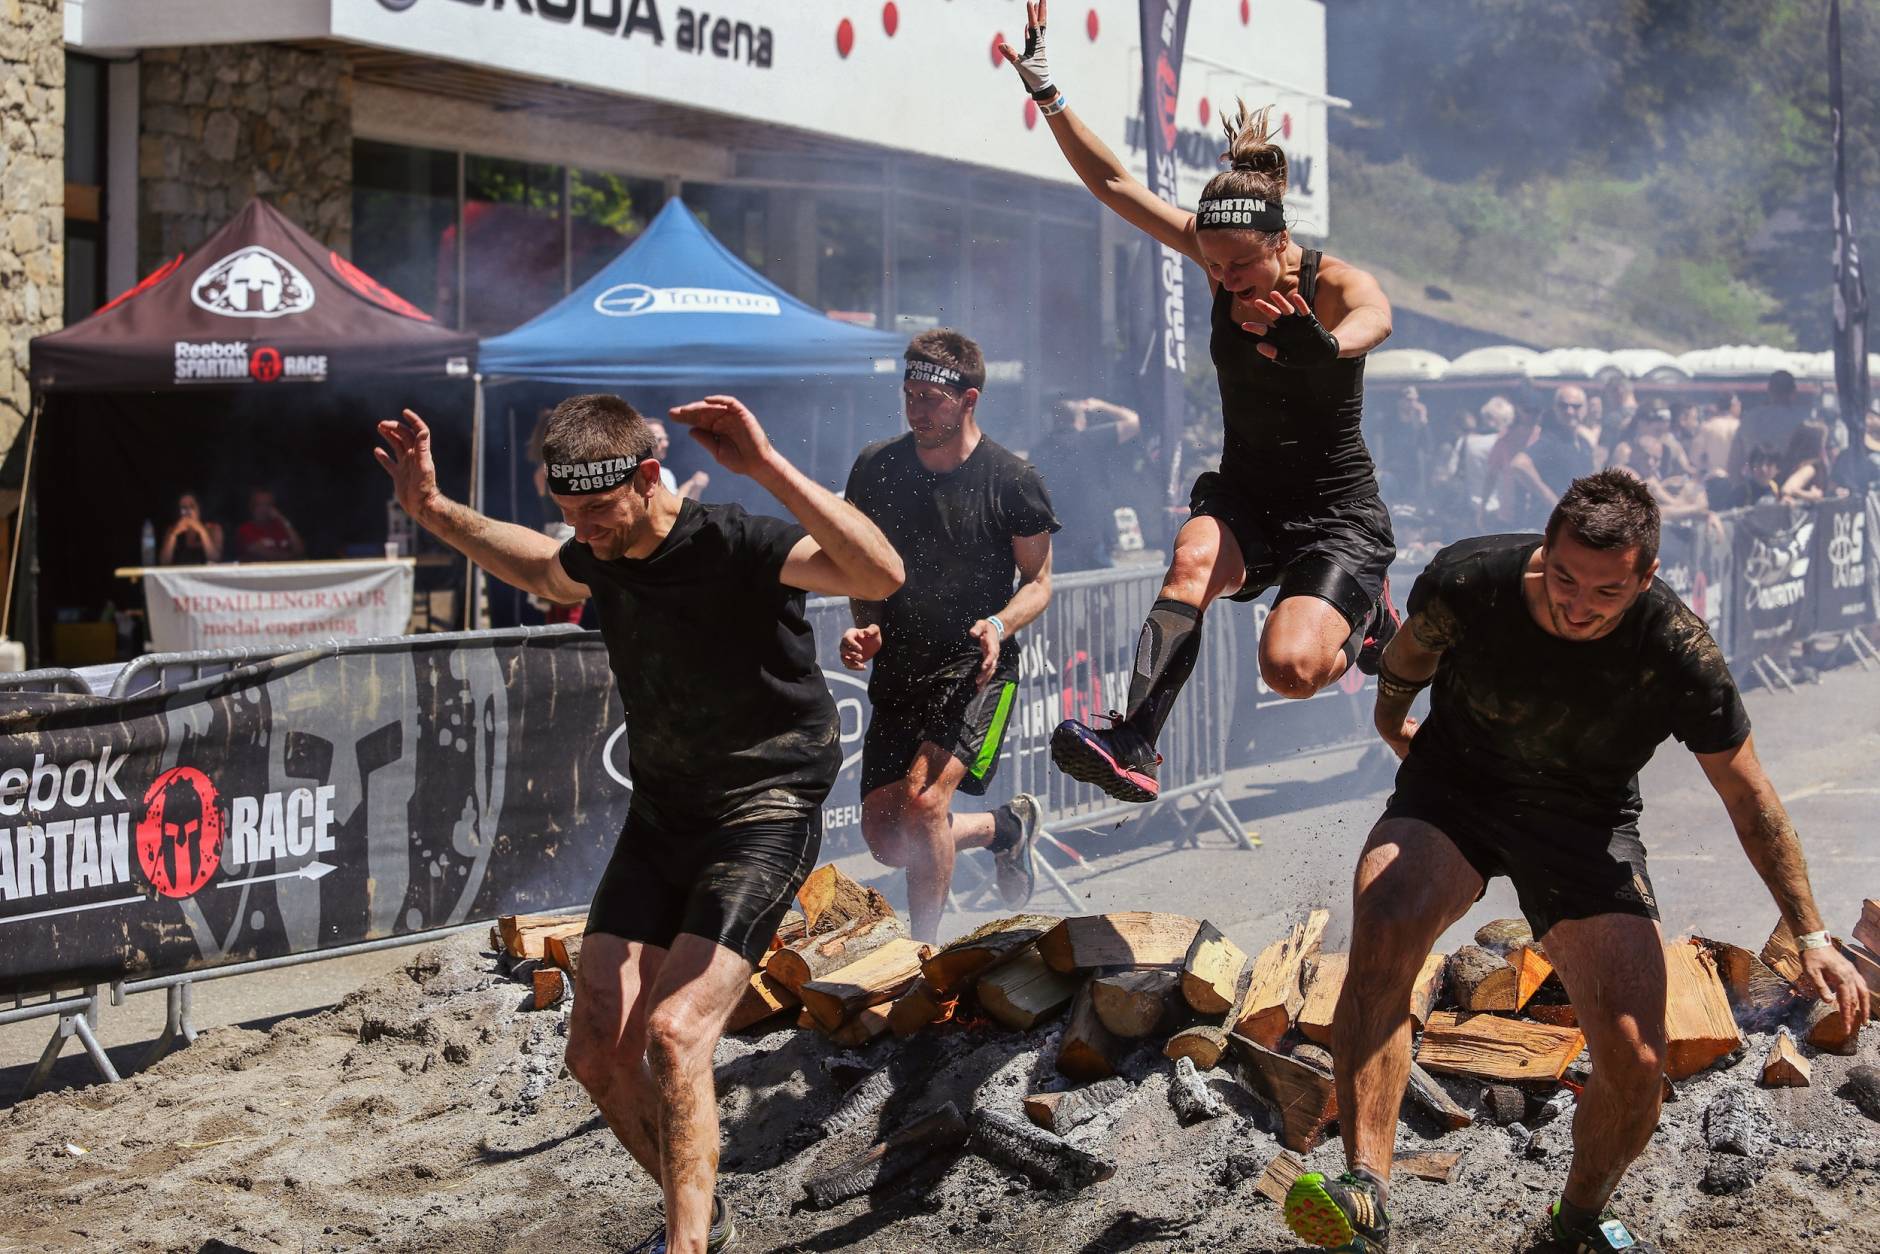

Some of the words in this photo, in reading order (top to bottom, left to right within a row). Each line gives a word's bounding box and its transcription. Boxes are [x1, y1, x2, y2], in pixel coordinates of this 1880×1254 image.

[676, 6, 773, 69] arena
[1199, 198, 1267, 213] SPARTAN
[1202, 211, 1252, 225] 20980
[174, 341, 248, 358] Reebok
[174, 358, 249, 378] SPARTAN
[283, 355, 328, 376] RACE
[551, 455, 637, 478] SPARTAN
[174, 587, 386, 614] MEDAILLENGRAVUR
[202, 617, 260, 636] medal
[264, 617, 358, 636] engraving
[0, 746, 130, 816] ebok
[0, 812, 130, 901] ARTAN
[232, 785, 336, 865] RACE
